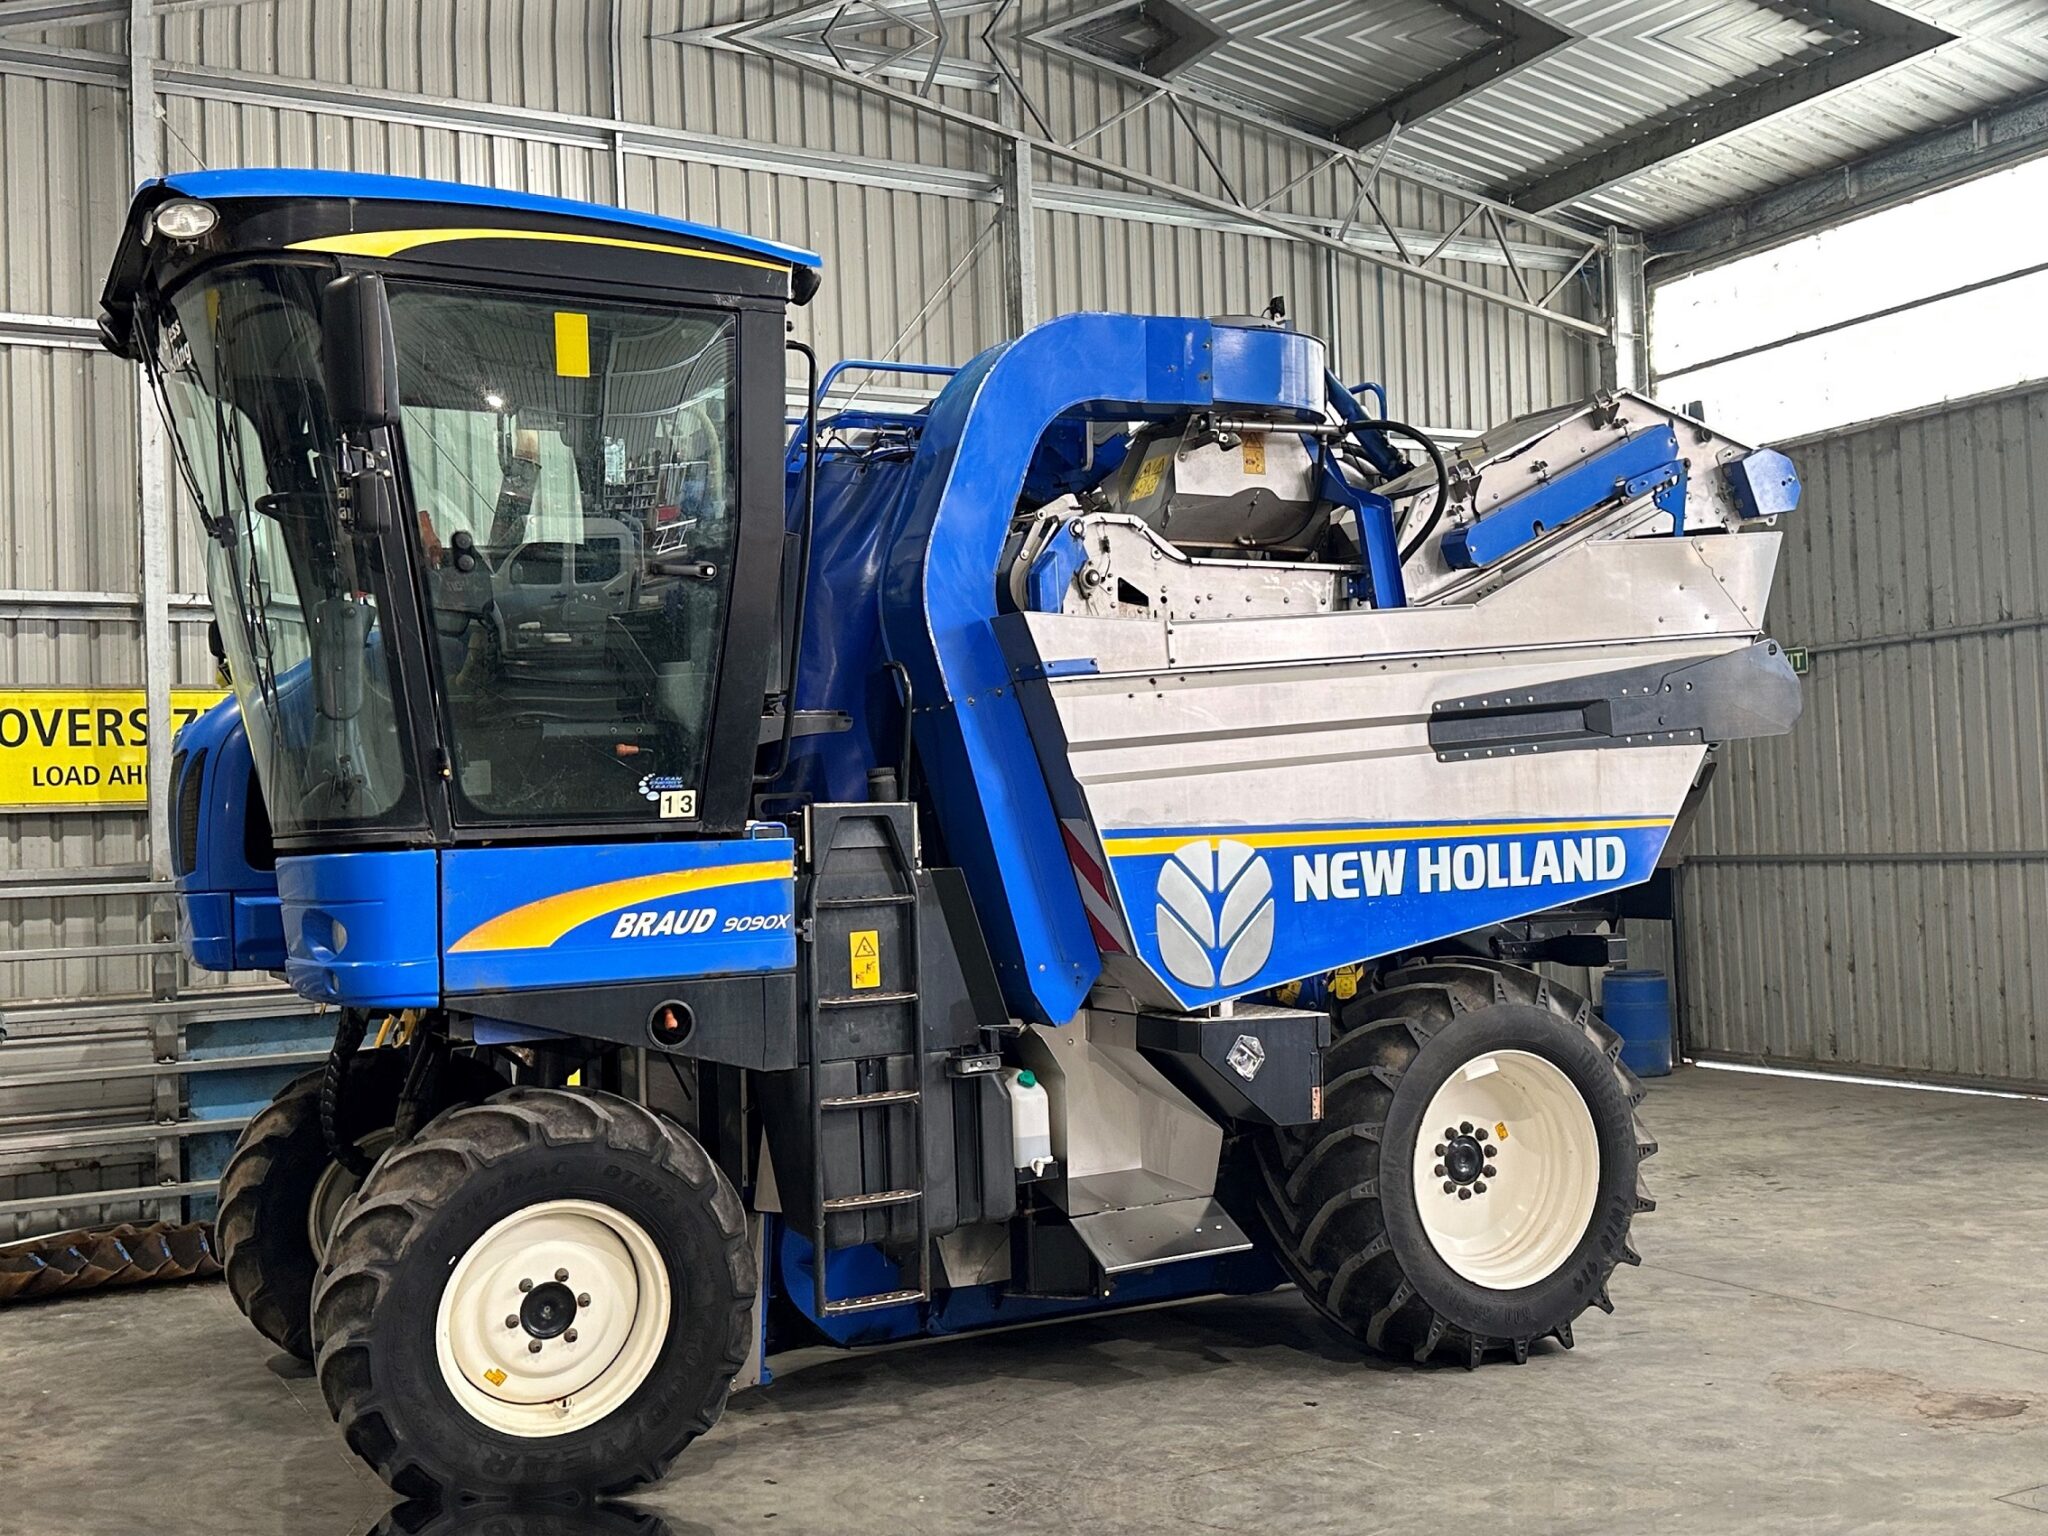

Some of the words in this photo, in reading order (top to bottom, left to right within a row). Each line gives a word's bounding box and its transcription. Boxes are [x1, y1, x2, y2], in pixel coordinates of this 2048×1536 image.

[1786, 652, 1803, 668] IT
[32, 766, 100, 786] LOAD
[665, 795, 693, 814] 13
[1293, 848, 1406, 903] NEW
[1418, 836, 1626, 893] HOLLAND
[611, 908, 718, 939] BRAUD
[722, 914, 792, 933] 9090X
